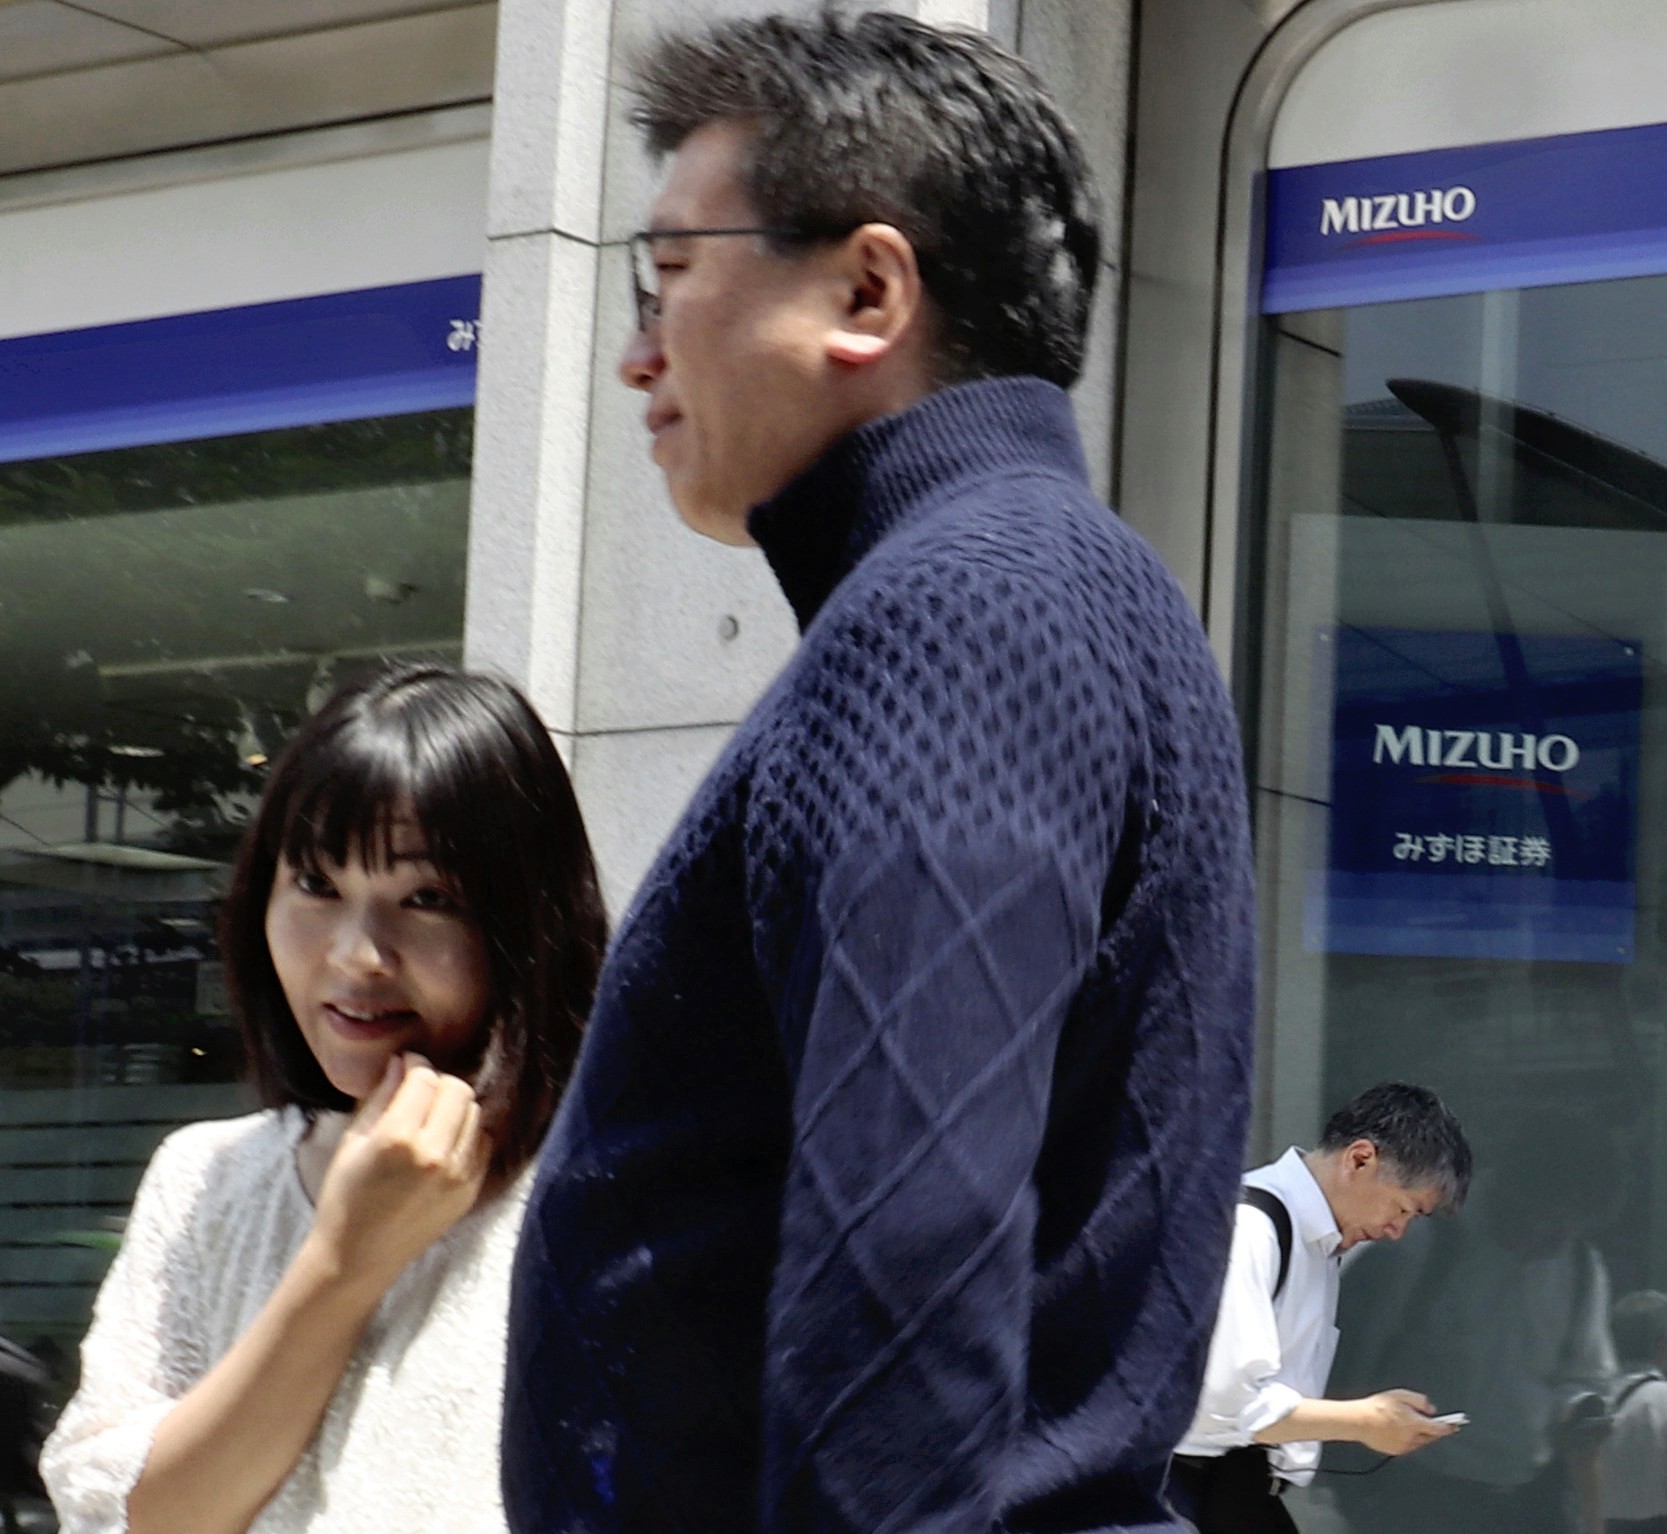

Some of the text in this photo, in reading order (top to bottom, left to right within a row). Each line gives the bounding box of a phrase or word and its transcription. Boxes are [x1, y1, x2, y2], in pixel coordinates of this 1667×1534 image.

[1319, 186, 1476, 236] MIZUHO
[446, 318, 483, 352] み
[1373, 723, 1580, 772] MIZUHO
[1392, 831, 1552, 867] みずほ証券
